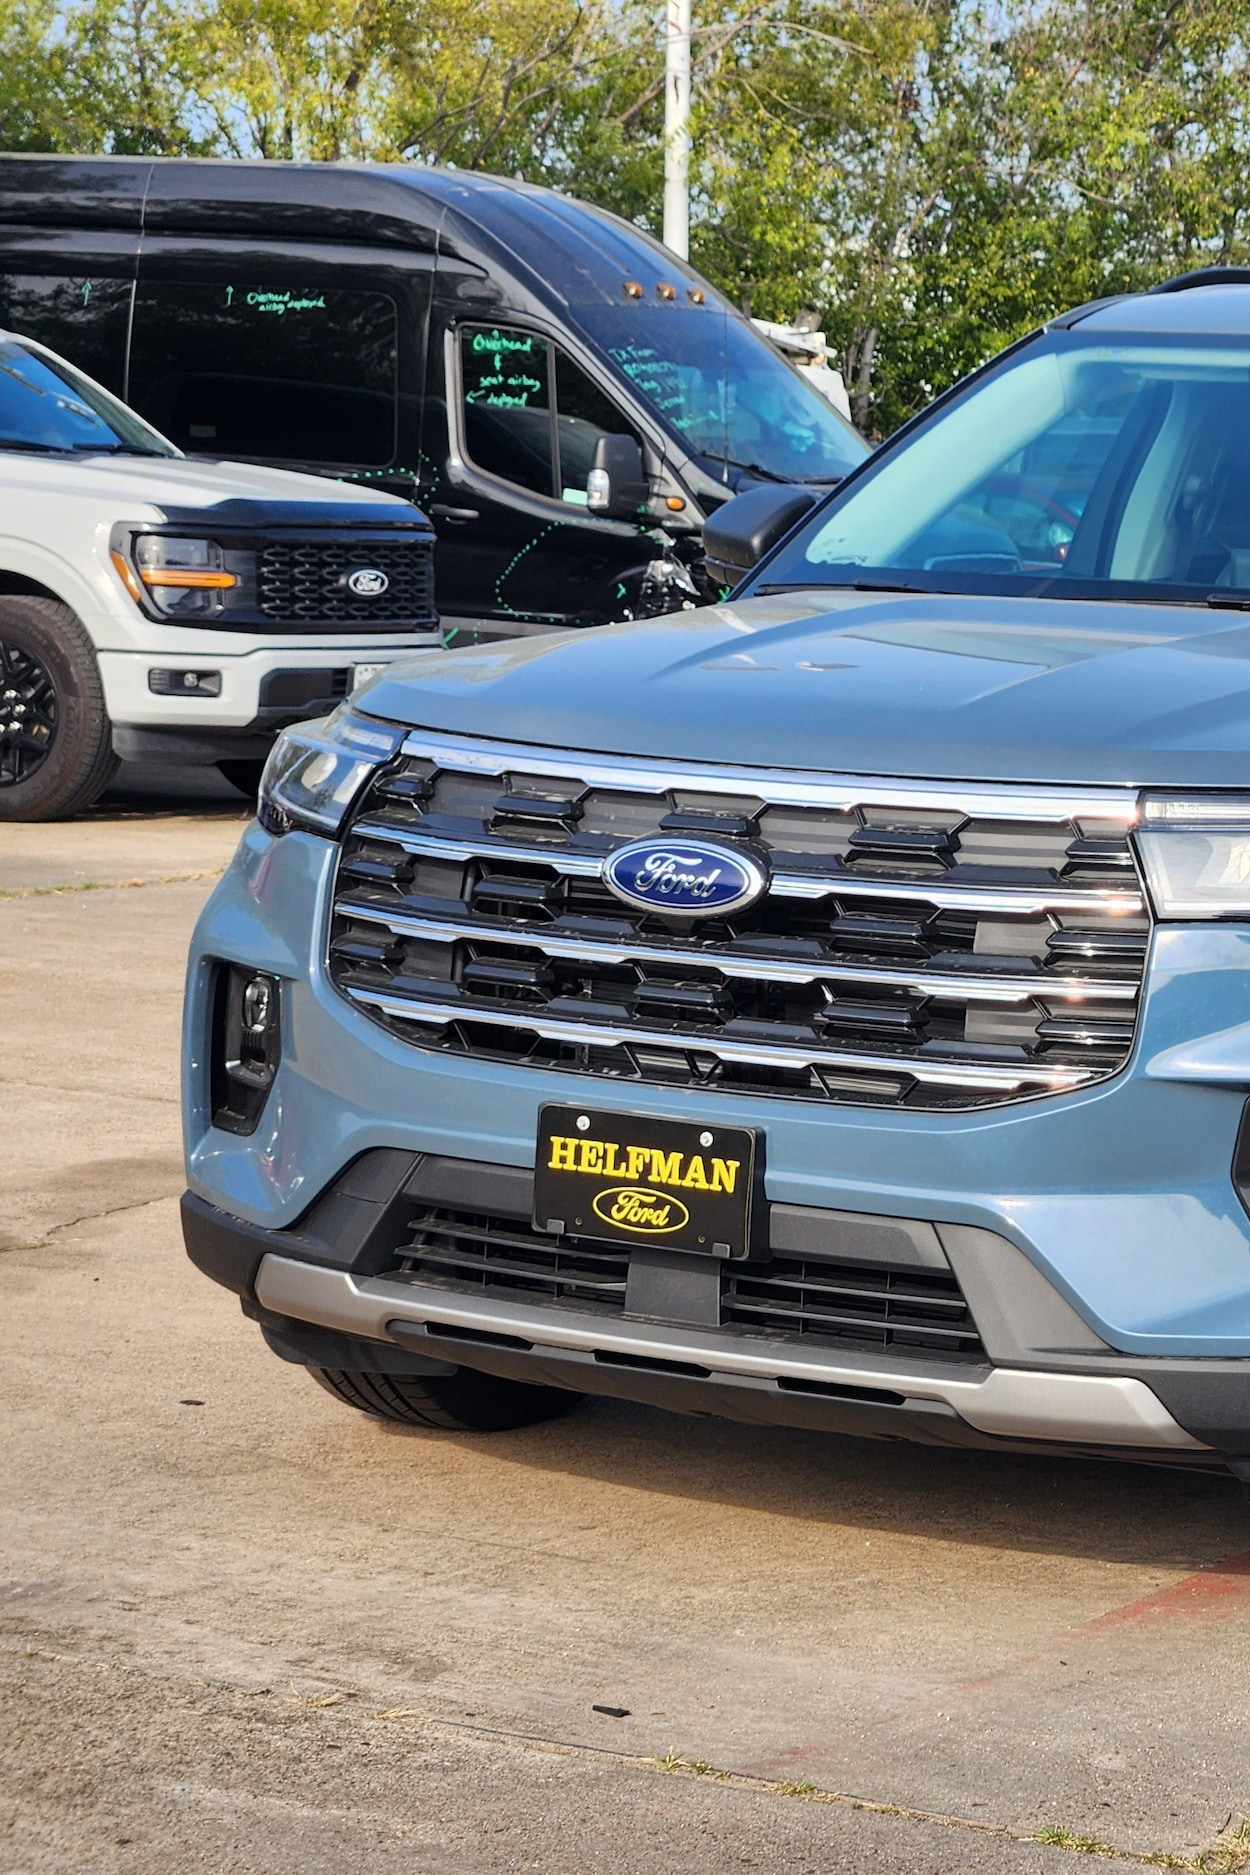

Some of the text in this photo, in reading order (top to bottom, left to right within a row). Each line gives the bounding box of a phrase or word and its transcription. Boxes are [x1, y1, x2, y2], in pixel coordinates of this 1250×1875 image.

[634, 852, 722, 898] Ford
[547, 1135, 741, 1194] HELFMAN
[610, 1190, 671, 1228] Ford
